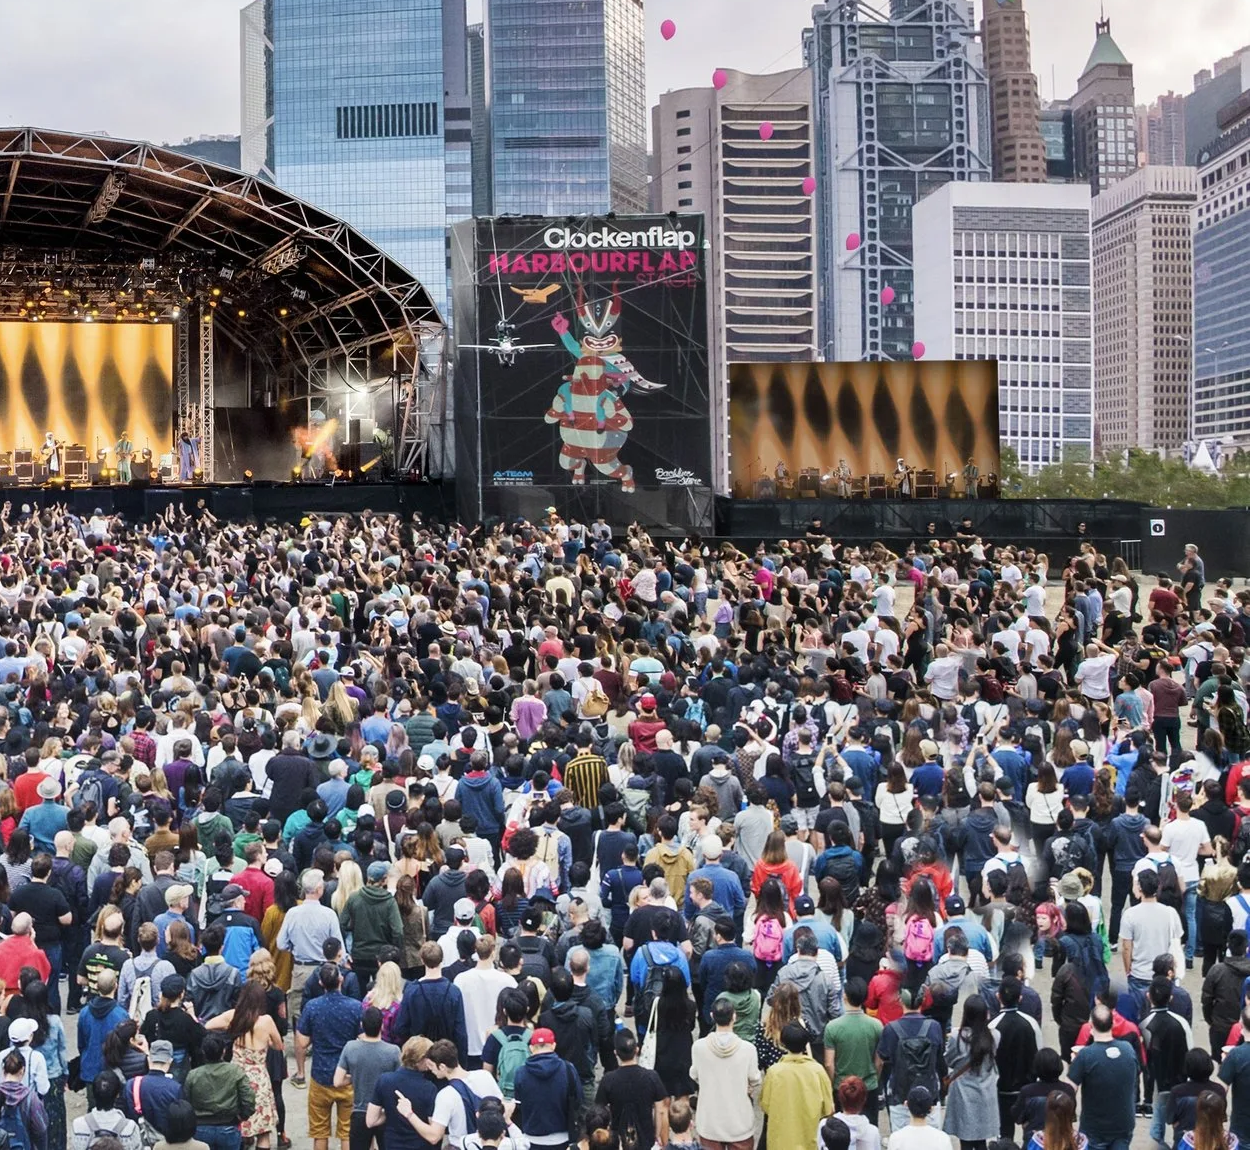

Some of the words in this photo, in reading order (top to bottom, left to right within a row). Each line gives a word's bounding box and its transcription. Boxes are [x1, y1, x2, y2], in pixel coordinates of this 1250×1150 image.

[543, 226, 696, 251] Clockenflap
[489, 250, 697, 274] HARBOURFLAP
[635, 271, 697, 288] STAGE
